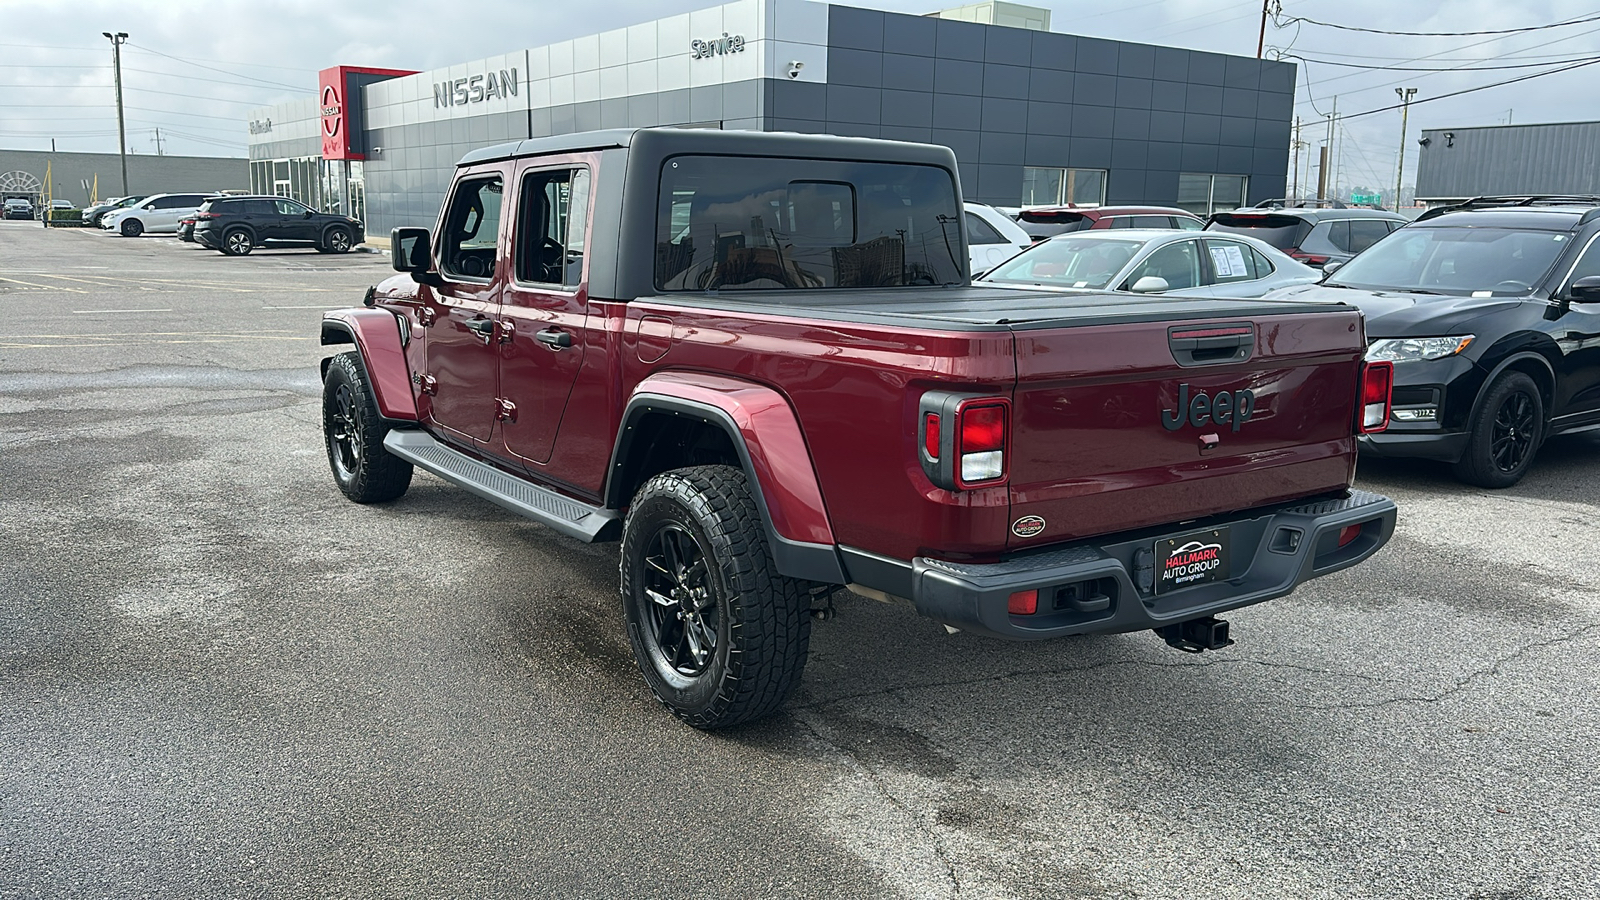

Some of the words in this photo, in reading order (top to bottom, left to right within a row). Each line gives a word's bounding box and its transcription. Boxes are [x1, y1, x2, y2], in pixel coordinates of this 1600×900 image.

[691, 32, 745, 60] Service
[433, 67, 518, 109] NISSAN
[321, 105, 340, 117] NISSAN
[1161, 383, 1255, 433] Jeep
[1162, 566, 1187, 581] AUTO
[1187, 558, 1220, 574] GROUP
[1165, 548, 1218, 569] HALLMARK
[1175, 572, 1205, 584] Birmingham
